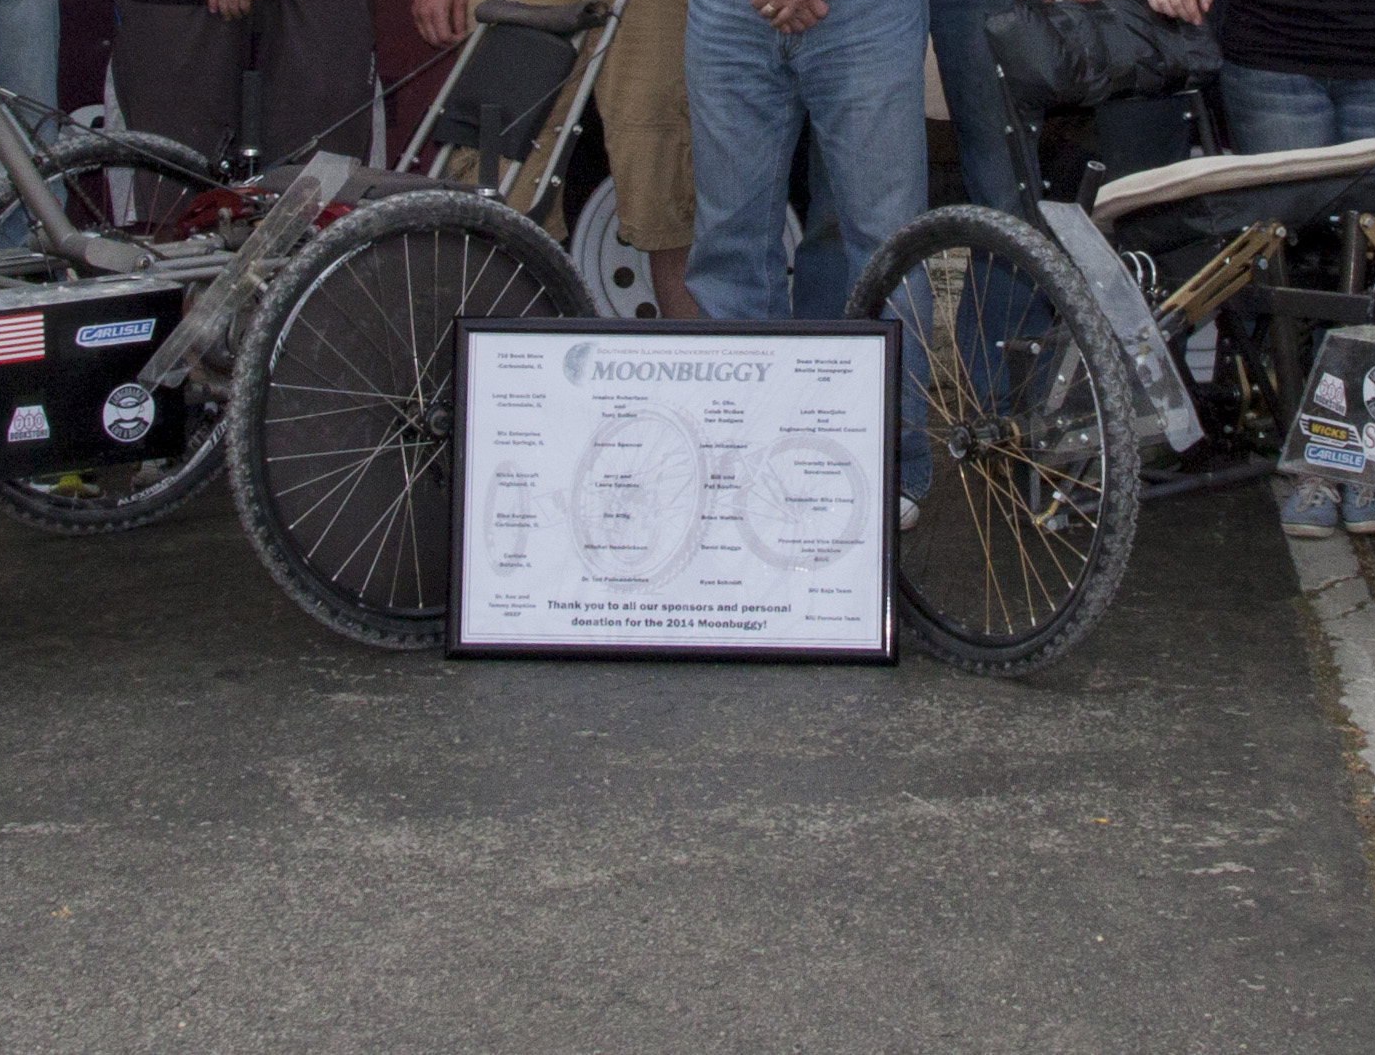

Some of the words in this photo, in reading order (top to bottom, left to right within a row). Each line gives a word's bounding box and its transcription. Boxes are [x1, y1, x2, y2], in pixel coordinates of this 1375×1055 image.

[80, 321, 151, 342] CARLISLE
[590, 360, 775, 383] MOONBUGGY
[1310, 423, 1348, 441] WICKS
[1306, 447, 1365, 468] CARLISLE
[547, 600, 582, 611] Thank
[584, 601, 605, 612] you
[607, 601, 619, 611] to
[622, 601, 637, 611] all
[639, 602, 658, 612] our
[661, 602, 714, 614] sponsors
[716, 603, 738, 613] and
[741, 603, 792, 615] personal
[571, 617, 622, 628] donation
[625, 617, 642, 627] for
[644, 617, 663, 628] the
[666, 618, 695, 629] 2014
[697, 618, 768, 631] Moonbuggy!
